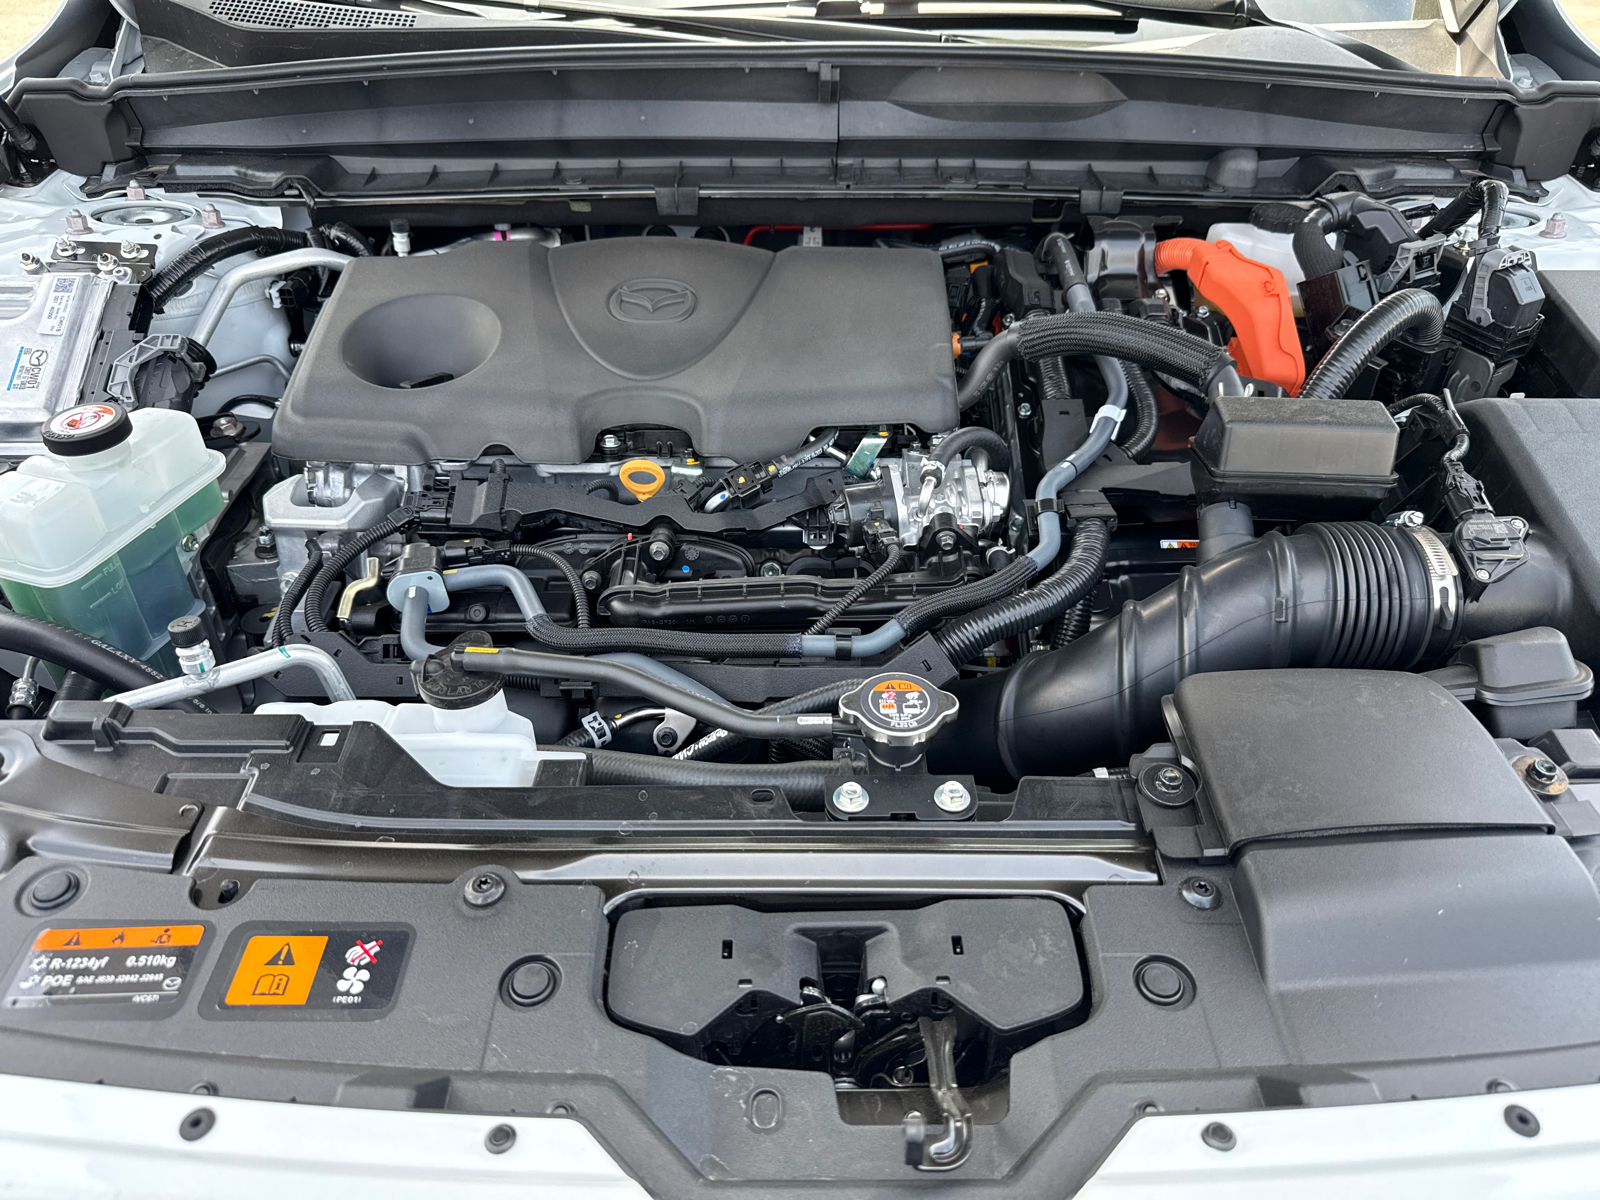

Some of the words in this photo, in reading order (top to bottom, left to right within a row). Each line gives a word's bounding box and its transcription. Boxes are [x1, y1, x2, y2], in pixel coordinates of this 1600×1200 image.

[26, 367, 42, 389] CW01
[102, 559, 120, 576] FULL
[91, 639, 139, 664] GALAXY
[49, 956, 110, 971] R-1234yf
[125, 954, 177, 969] 0.510kg
[40, 974, 74, 987] POE
[75, 975, 95, 985] SAE
[332, 995, 362, 1004] (PE01)
